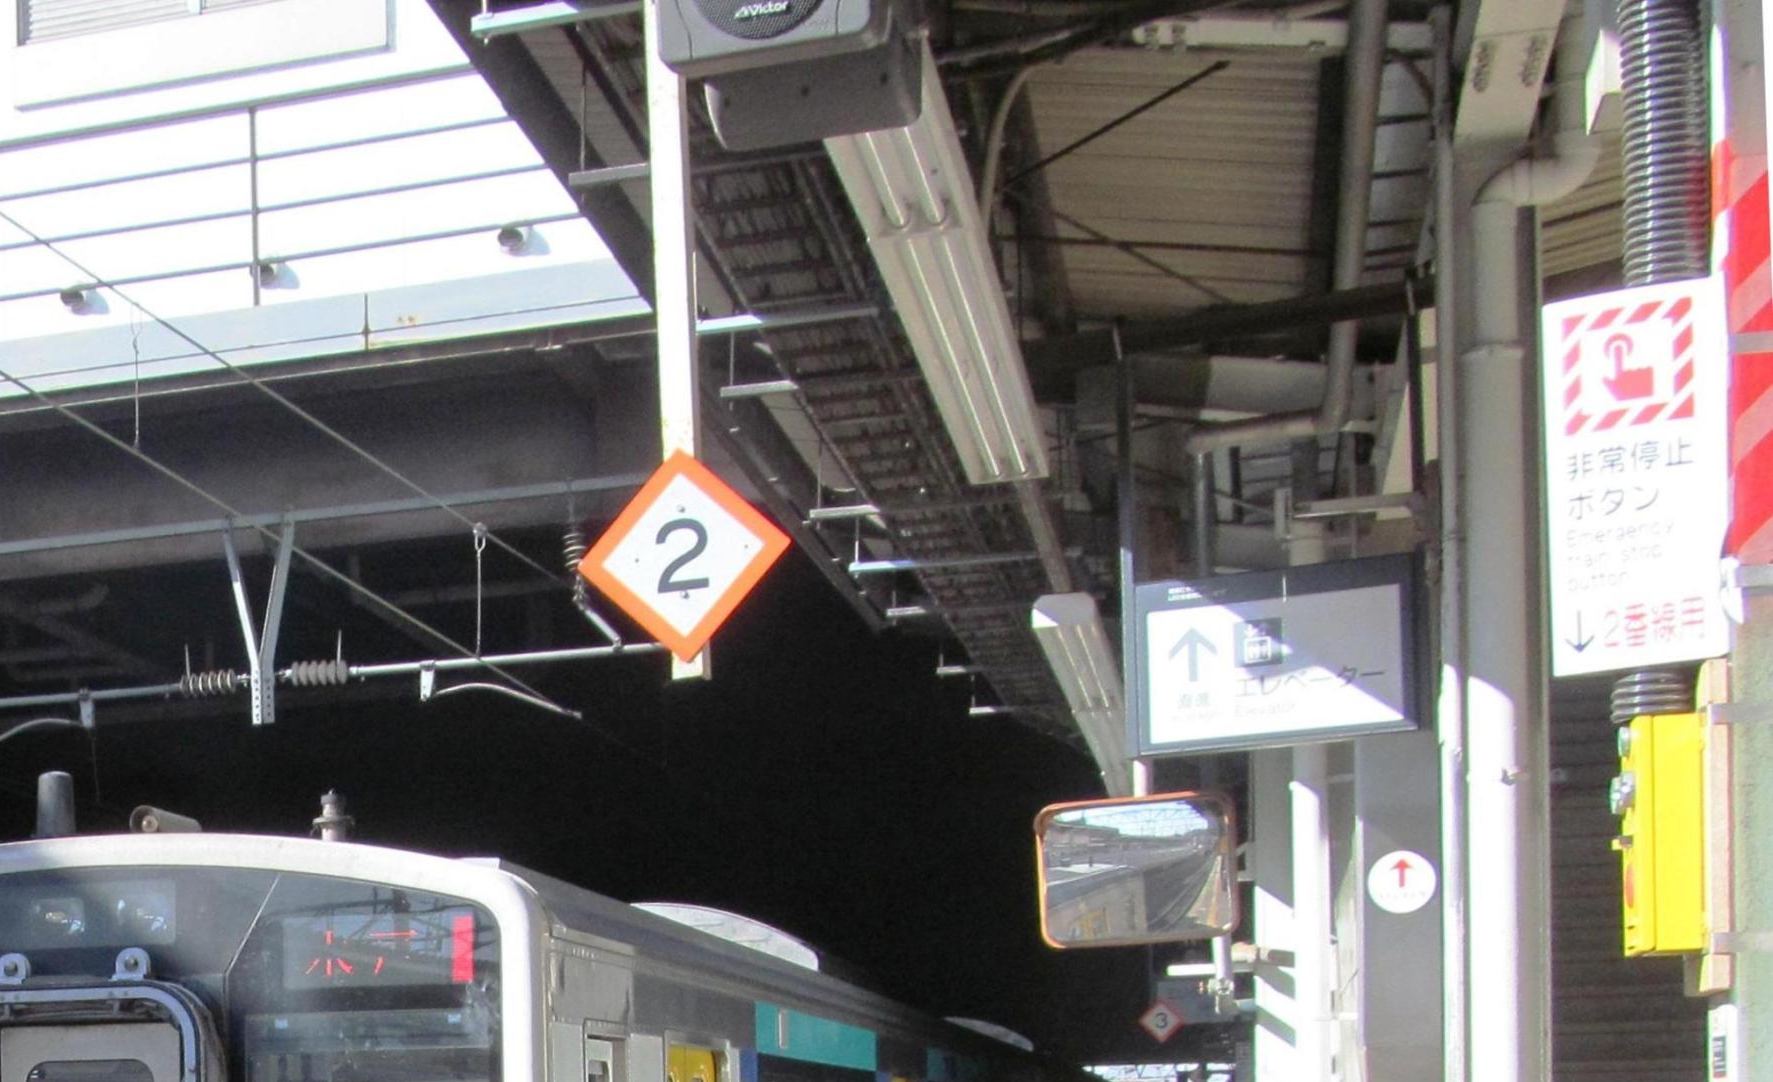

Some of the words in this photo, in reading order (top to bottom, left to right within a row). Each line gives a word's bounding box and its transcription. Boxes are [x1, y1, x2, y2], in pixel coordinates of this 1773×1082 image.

[1566, 436, 1695, 482] 非常停止
[1568, 486, 1660, 521] ボタン
[655, 517, 710, 594] 2
[1234, 665, 1385, 699] エレベーター
[1154, 1011, 1169, 1030] 3
